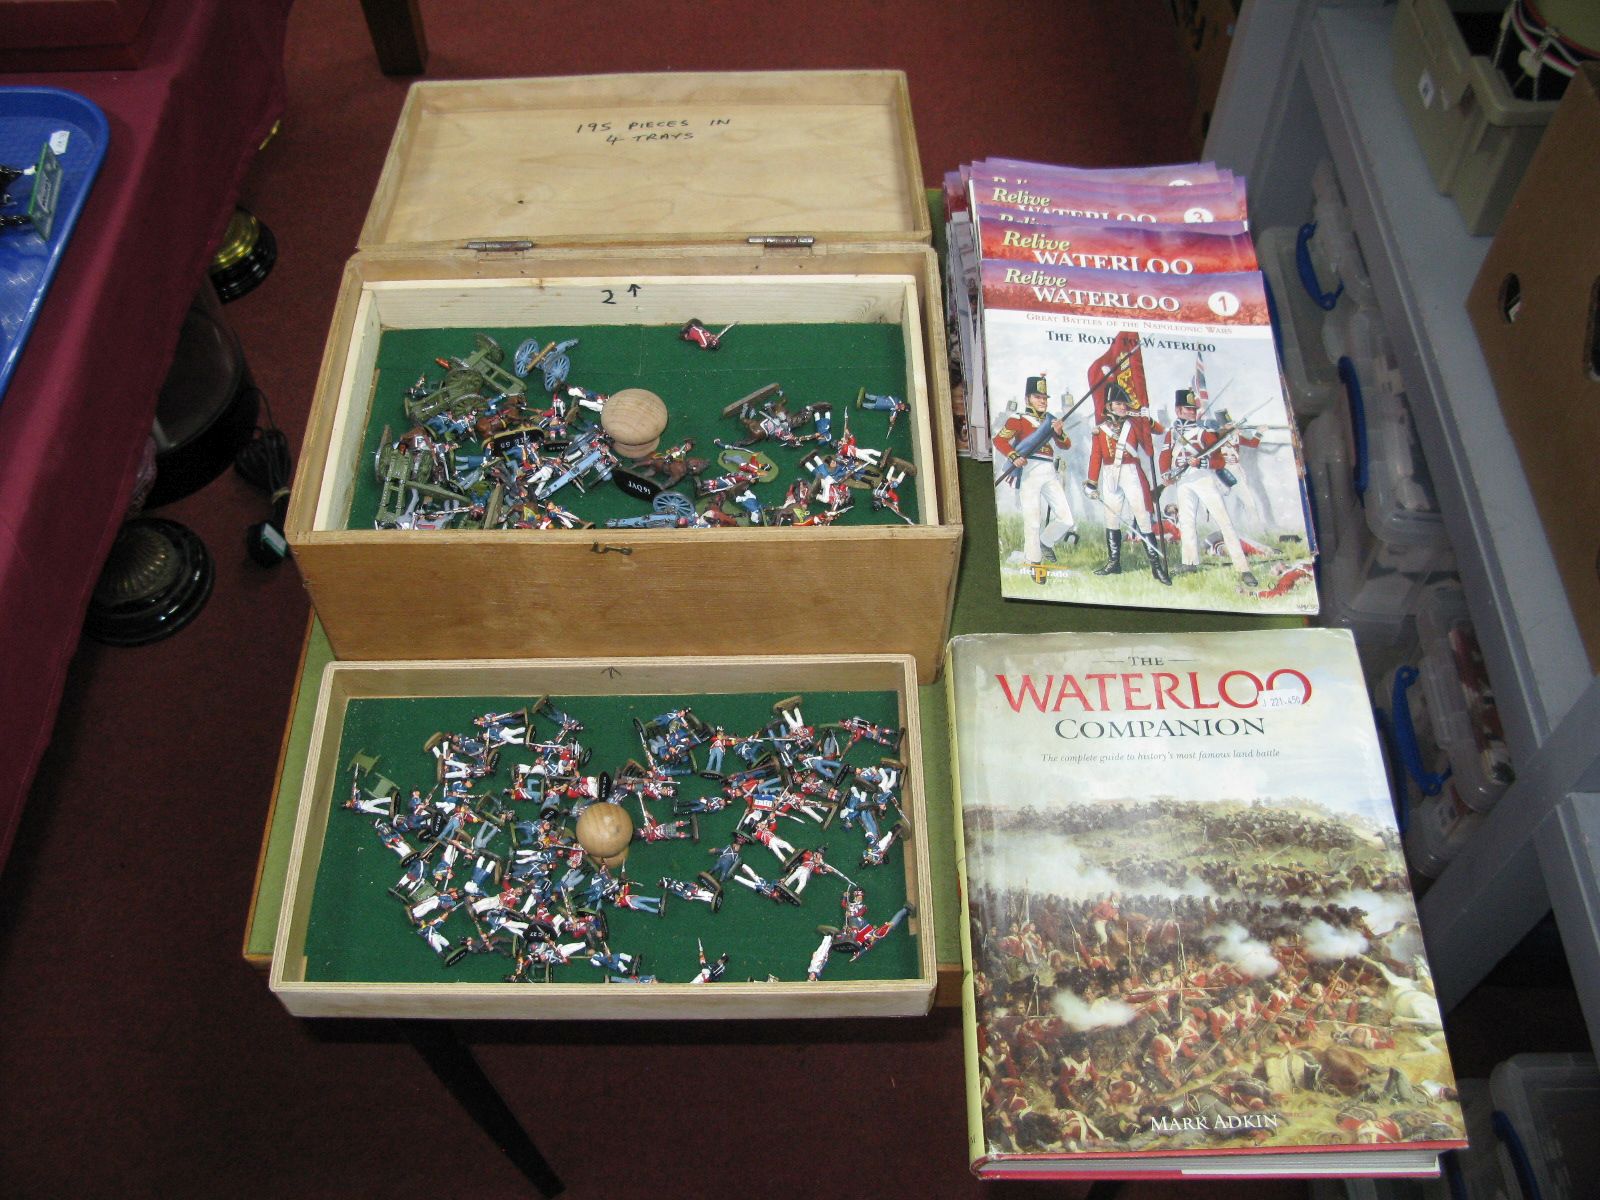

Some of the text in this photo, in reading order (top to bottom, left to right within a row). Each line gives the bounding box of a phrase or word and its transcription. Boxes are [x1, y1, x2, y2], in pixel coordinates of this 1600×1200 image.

[576, 118, 730, 133] 195 PIECES IN
[606, 132, 694, 145] 4 TRAYS
[992, 187, 1051, 207] Relive
[1002, 230, 1070, 251] Relive
[1032, 250, 1194, 275] WATERLOO
[1004, 268, 1068, 288] Relive
[601, 289, 617, 304] 2
[1033, 287, 1180, 312] WATERLOO
[1046, 330, 1073, 342] THE
[1143, 337, 1216, 352] WATERLOO
[1128, 656, 1165, 666] THE
[995, 668, 1312, 714] WATERLOO
[1055, 717, 1266, 740] COMPANION
[1041, 753, 1059, 762] The
[1060, 752, 1098, 765] complete
[1100, 752, 1124, 763] guide
[1127, 753, 1136, 761] to
[1176, 751, 1196, 760] most
[1198, 750, 1231, 761] famous
[1233, 749, 1254, 759] land
[1256, 748, 1280, 758] battle
[1151, 1114, 1278, 1131] MARK ADKIN
